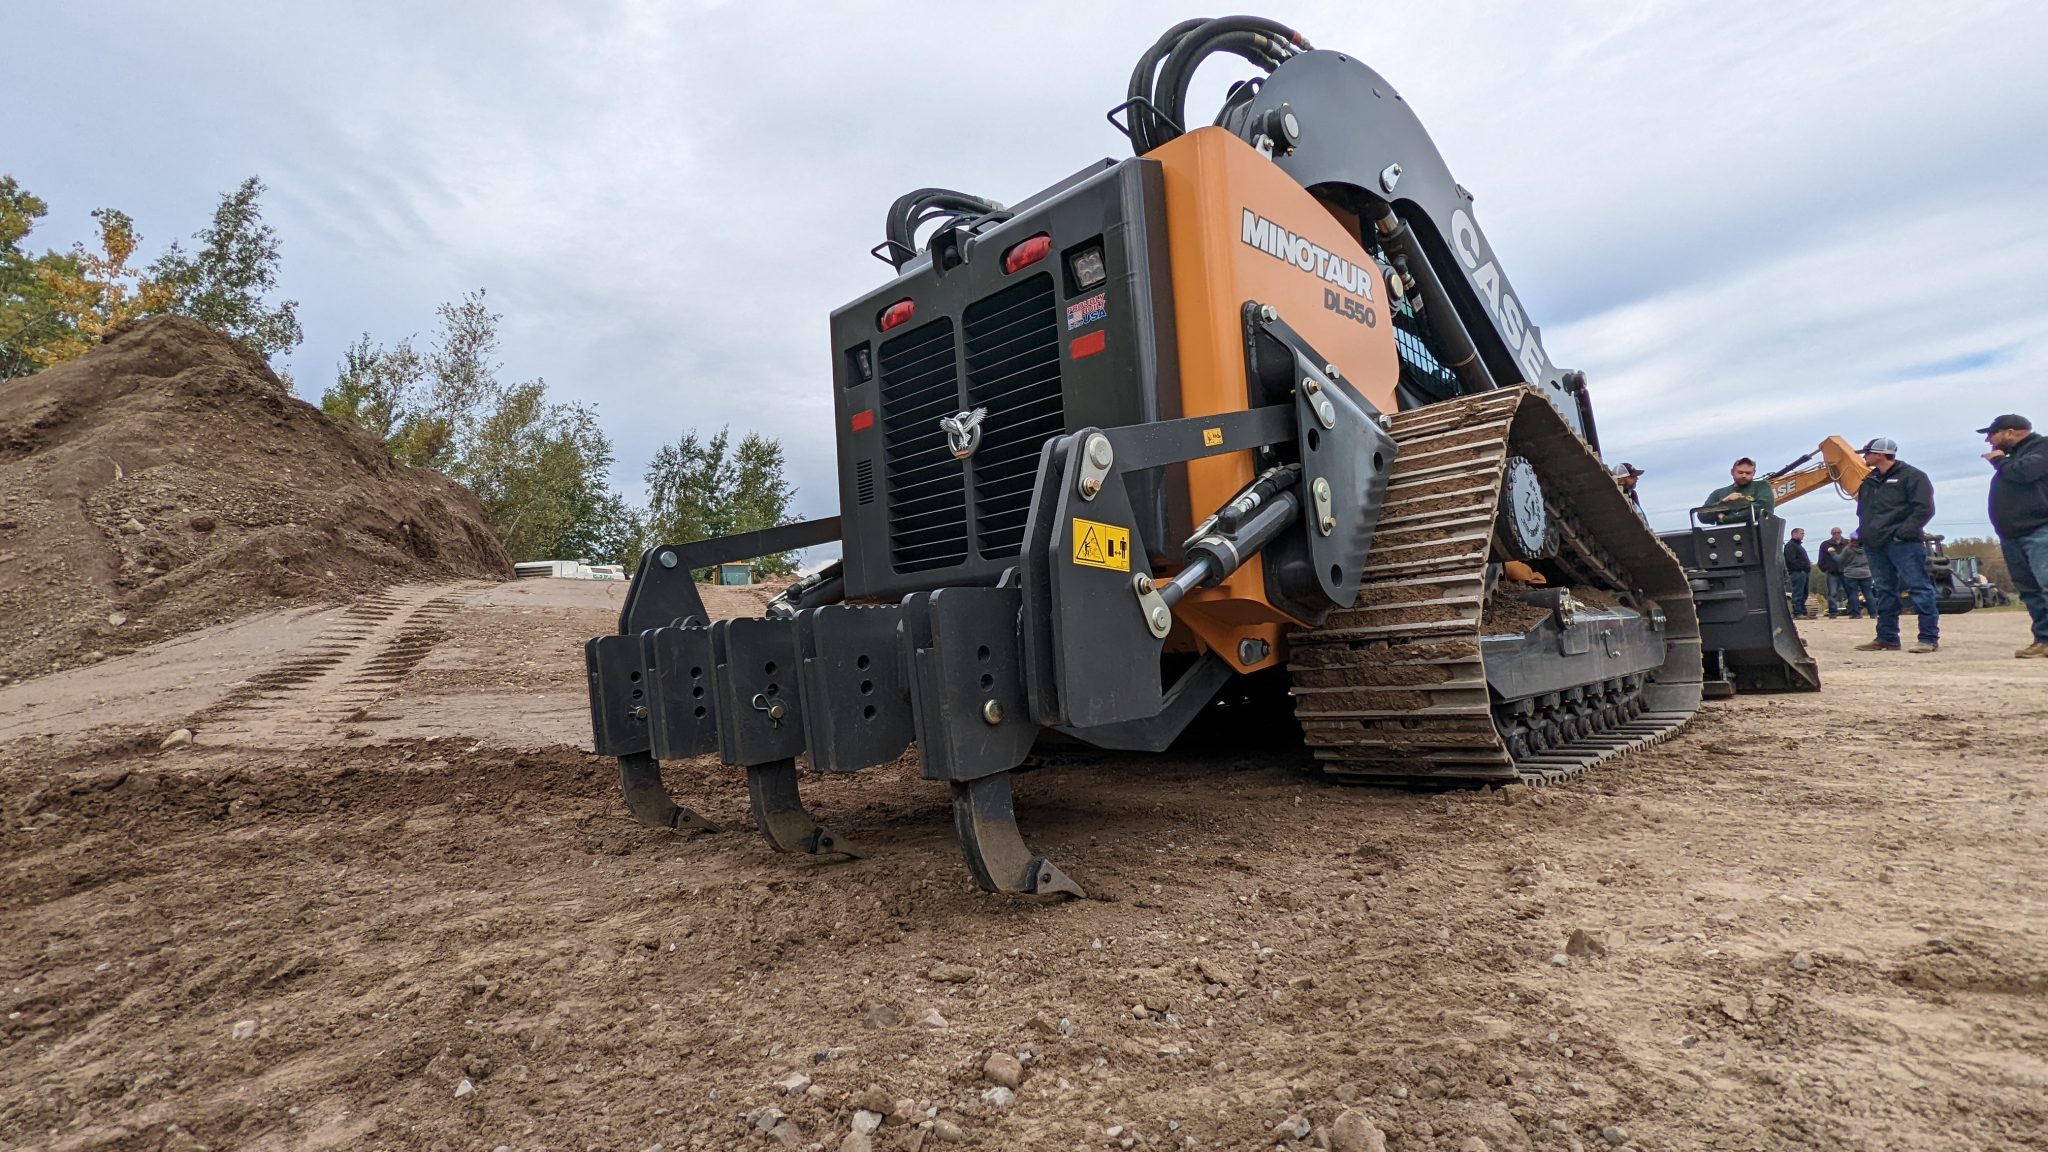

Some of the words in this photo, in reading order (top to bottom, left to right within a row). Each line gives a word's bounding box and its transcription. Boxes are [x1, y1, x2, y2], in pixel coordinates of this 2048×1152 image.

[1241, 207, 1374, 303] MINOTAUR
[1082, 308, 1107, 324] USA
[1323, 288, 1377, 329] DL550
[1452, 209, 1545, 388] CASE
[1772, 480, 1796, 499] SE
